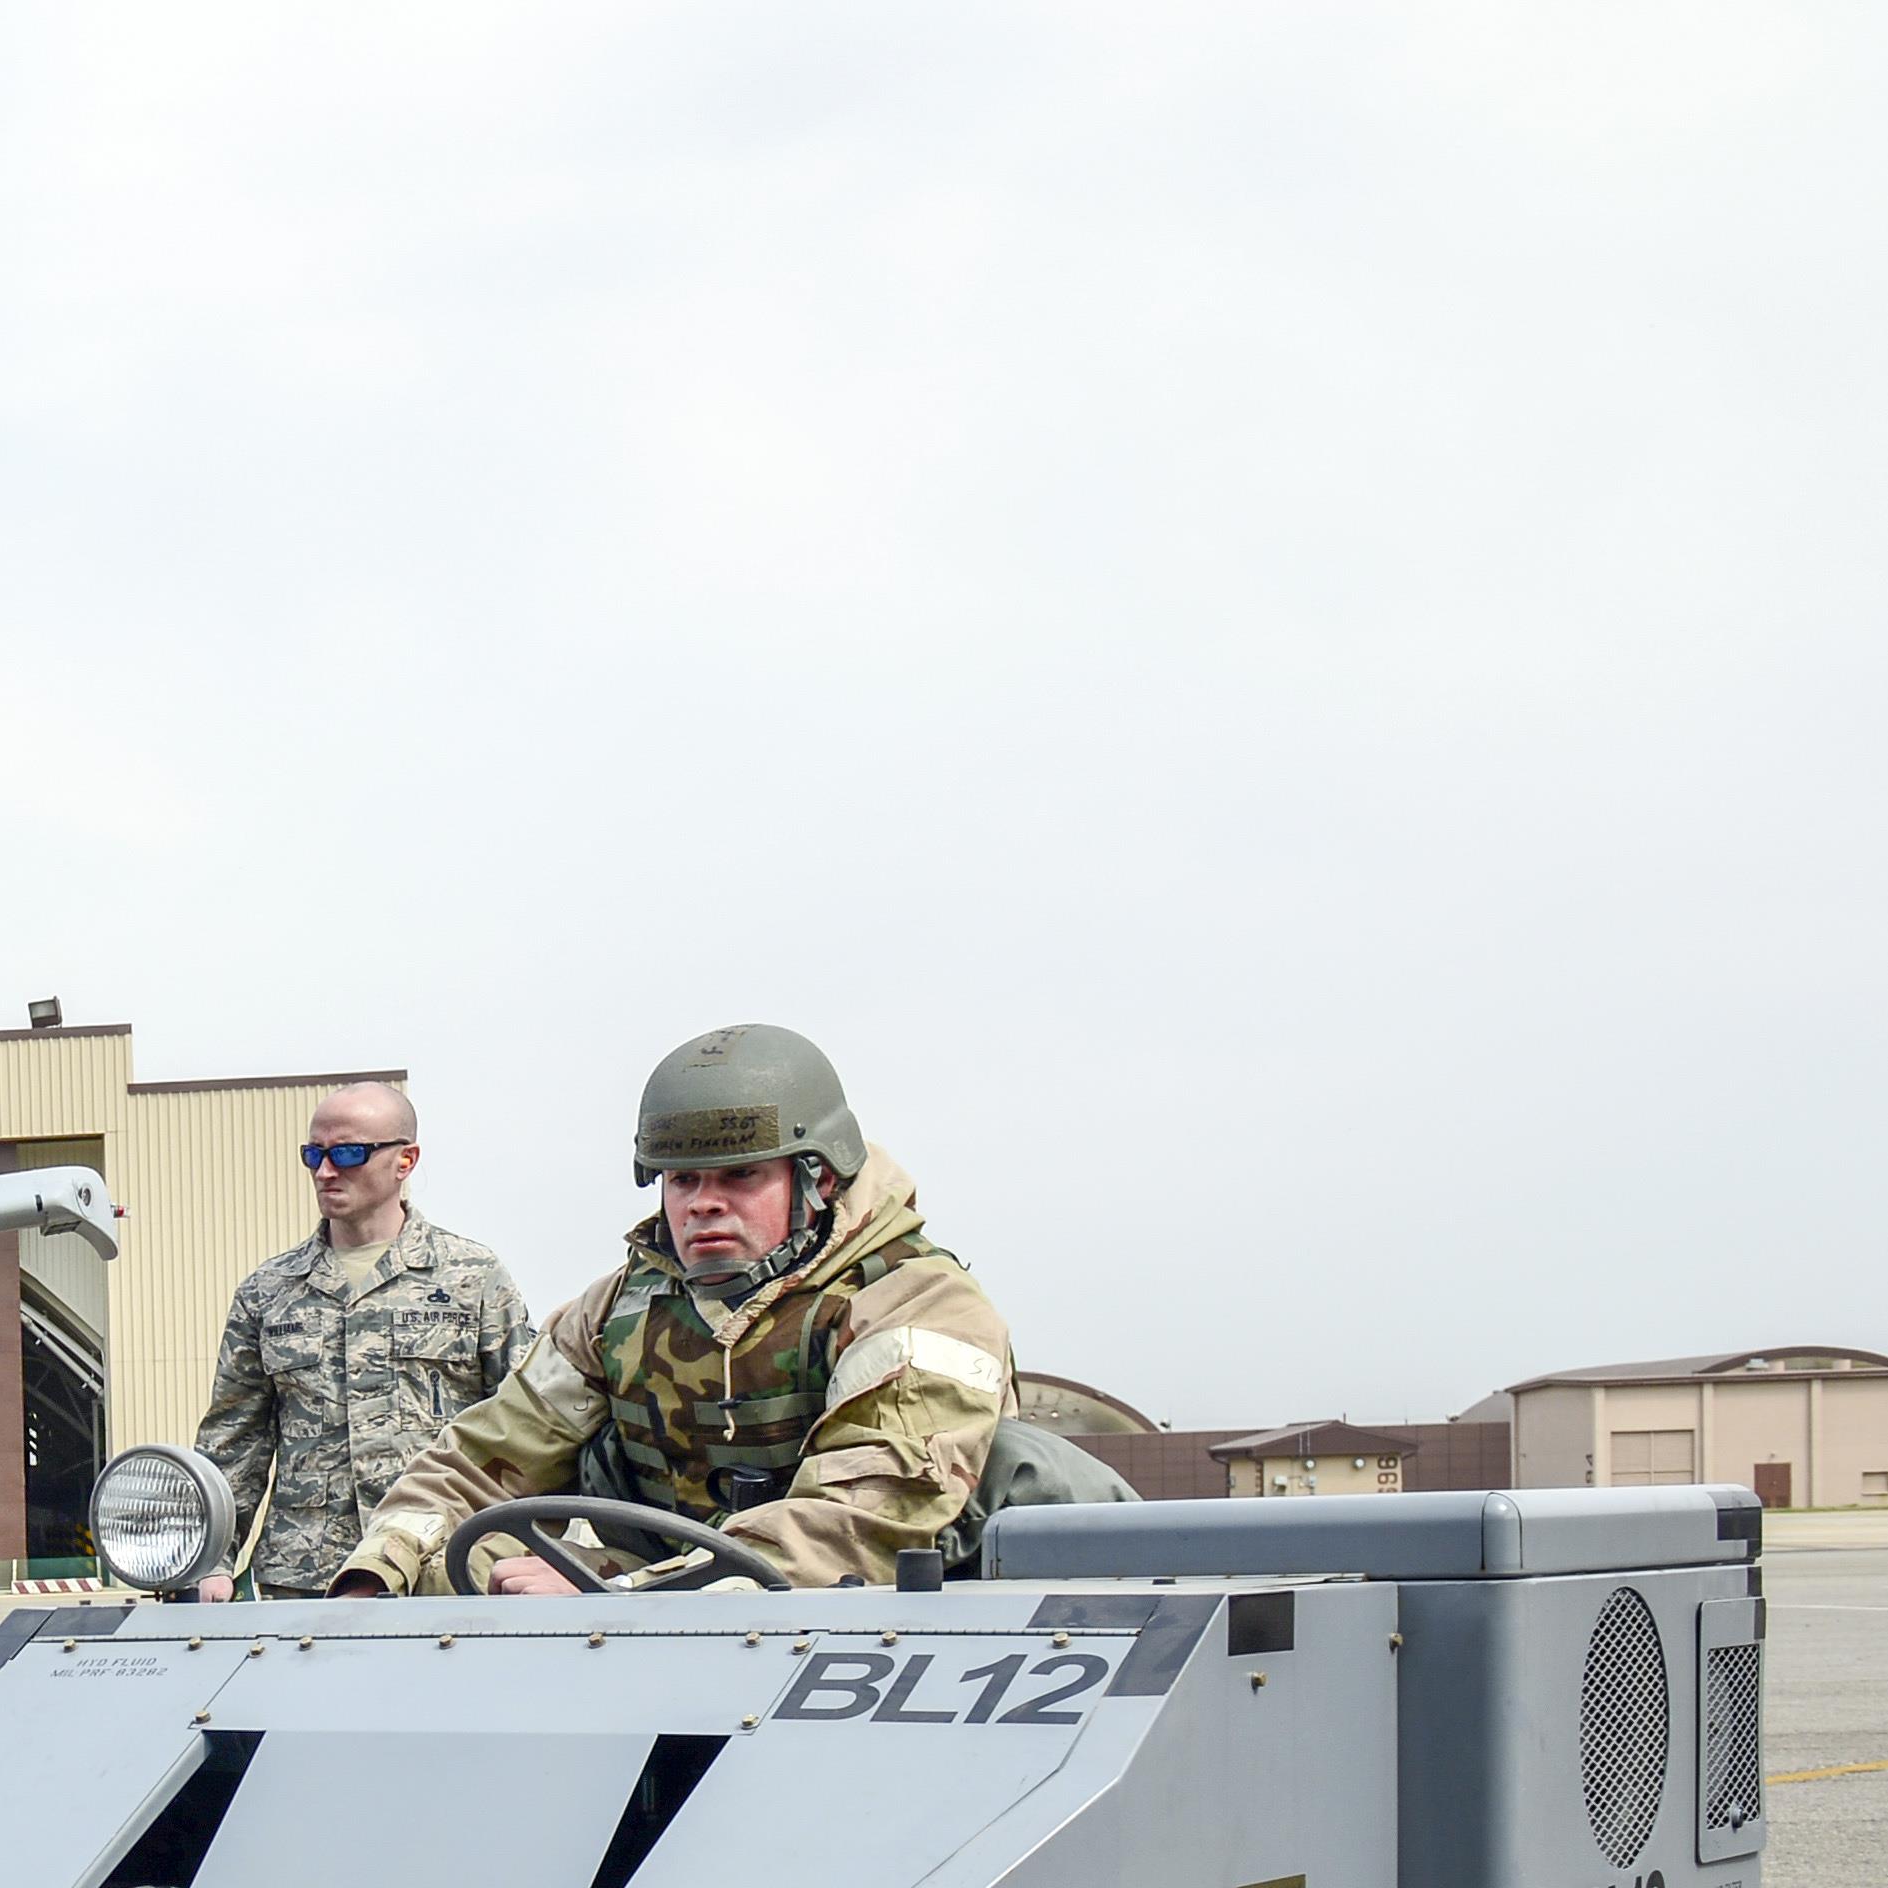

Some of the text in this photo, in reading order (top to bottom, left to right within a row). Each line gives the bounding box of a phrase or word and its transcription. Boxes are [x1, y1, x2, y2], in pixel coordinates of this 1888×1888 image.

[424, 1312, 440, 1322] AIR
[442, 1312, 471, 1325] FORCE
[77, 1657, 158, 1668] HYD FLUID
[771, 1652, 1109, 1725] BL12
